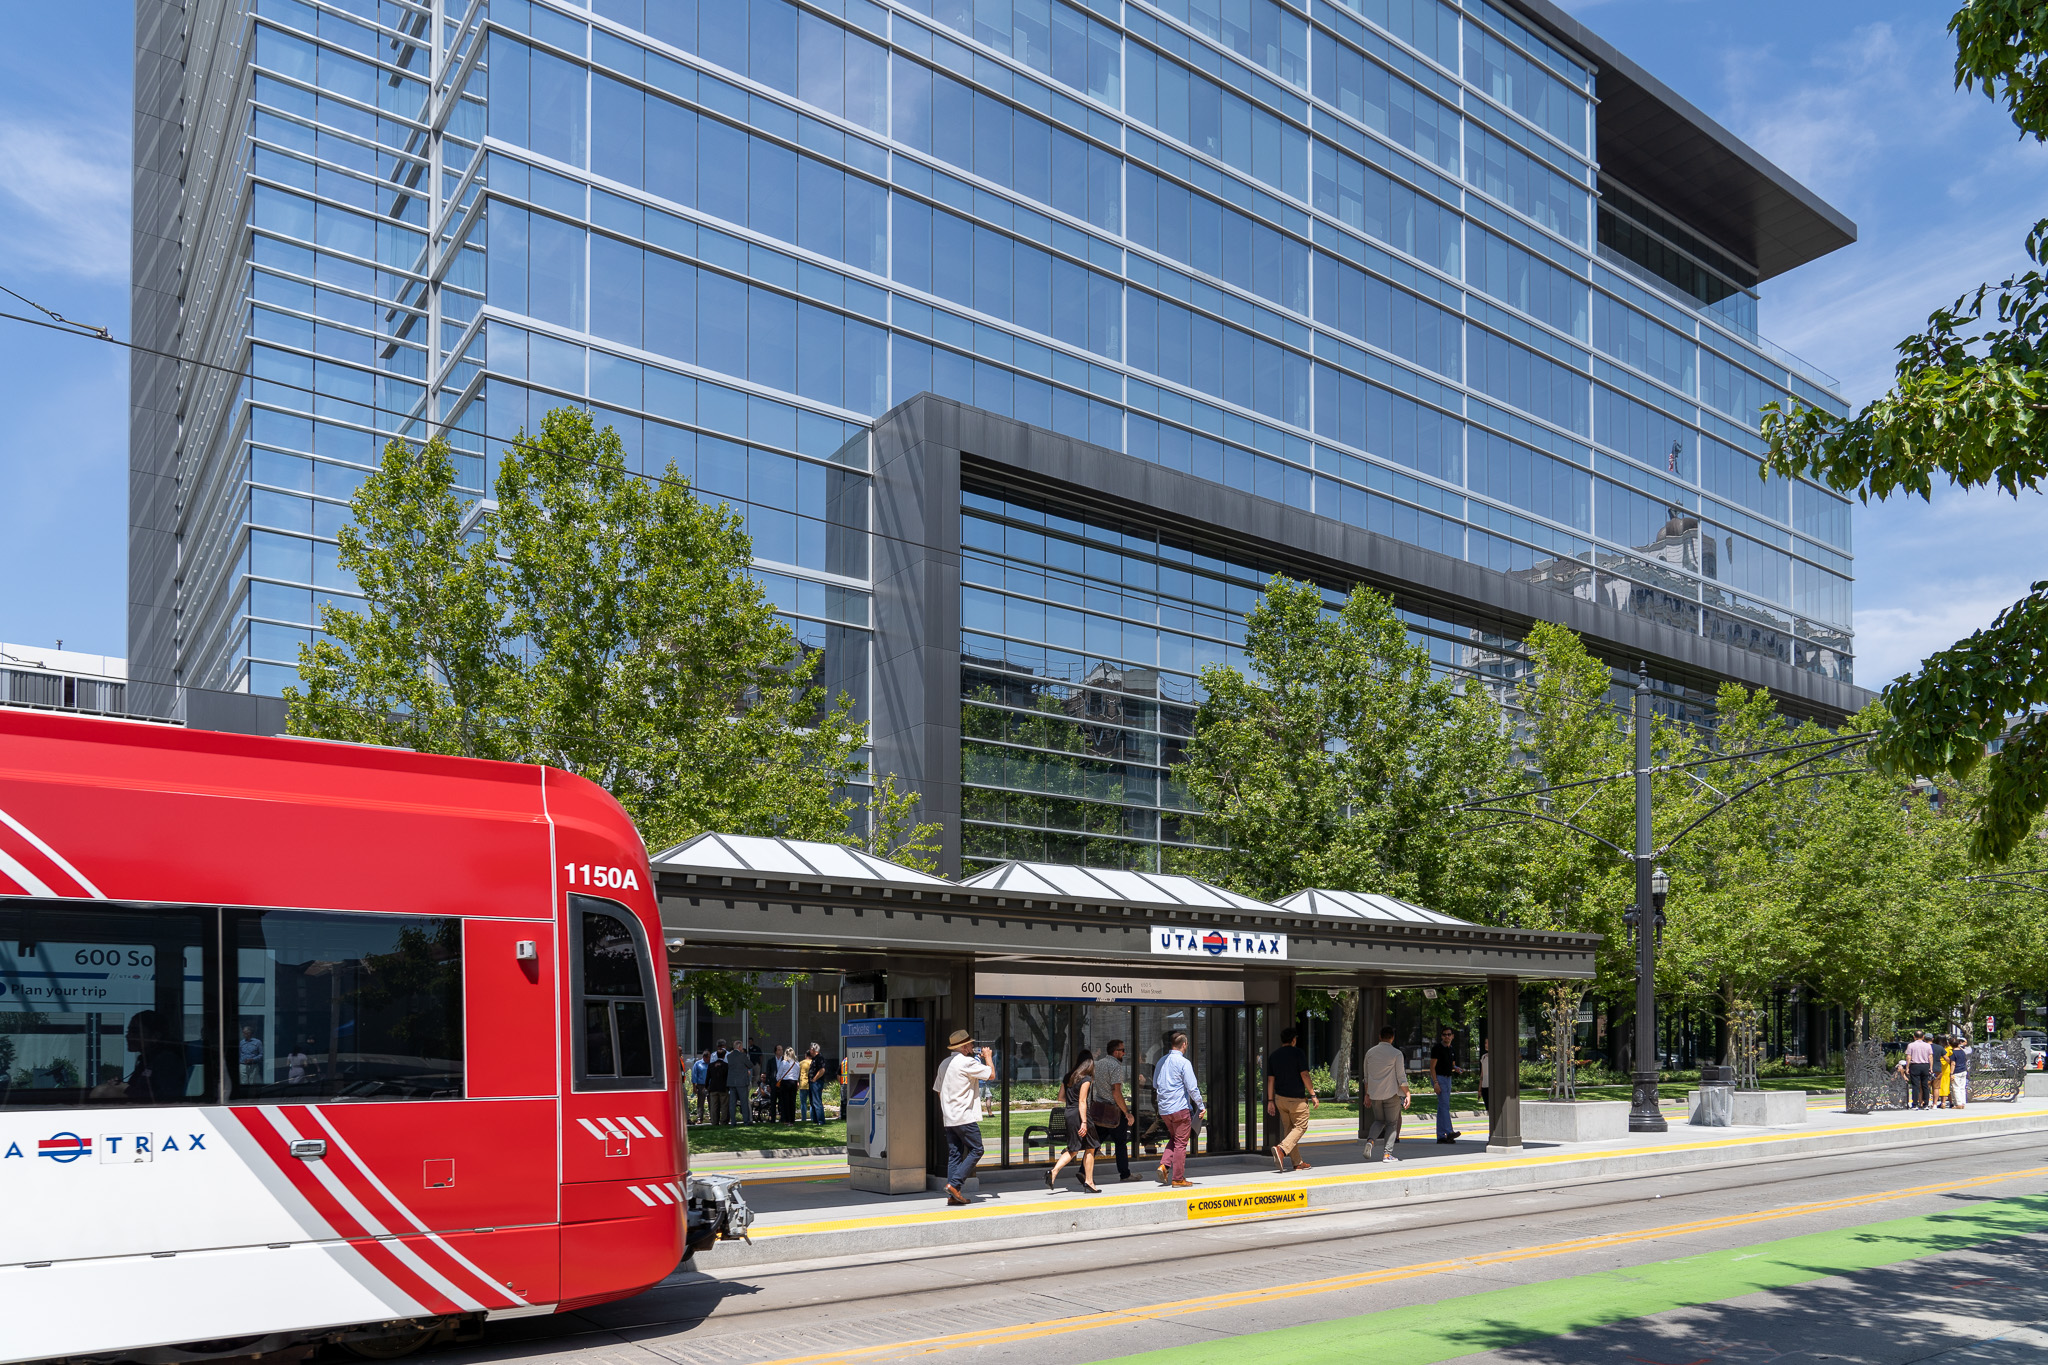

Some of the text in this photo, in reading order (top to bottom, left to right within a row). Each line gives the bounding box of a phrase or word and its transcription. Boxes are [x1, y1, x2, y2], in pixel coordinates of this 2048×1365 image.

[564, 862, 640, 891] 1150A
[1161, 933, 1279, 955] UTA TRAX
[75, 949, 121, 966] 600
[11, 983, 107, 998] Plan your trip
[1081, 982, 1133, 994] 600 South
[848, 1023, 870, 1035] Tickets
[851, 1051, 863, 1059] UTA
[105, 1133, 206, 1154] TRAX
[1198, 1193, 1296, 1211] CROSS ONLY AT CROSSWALK
